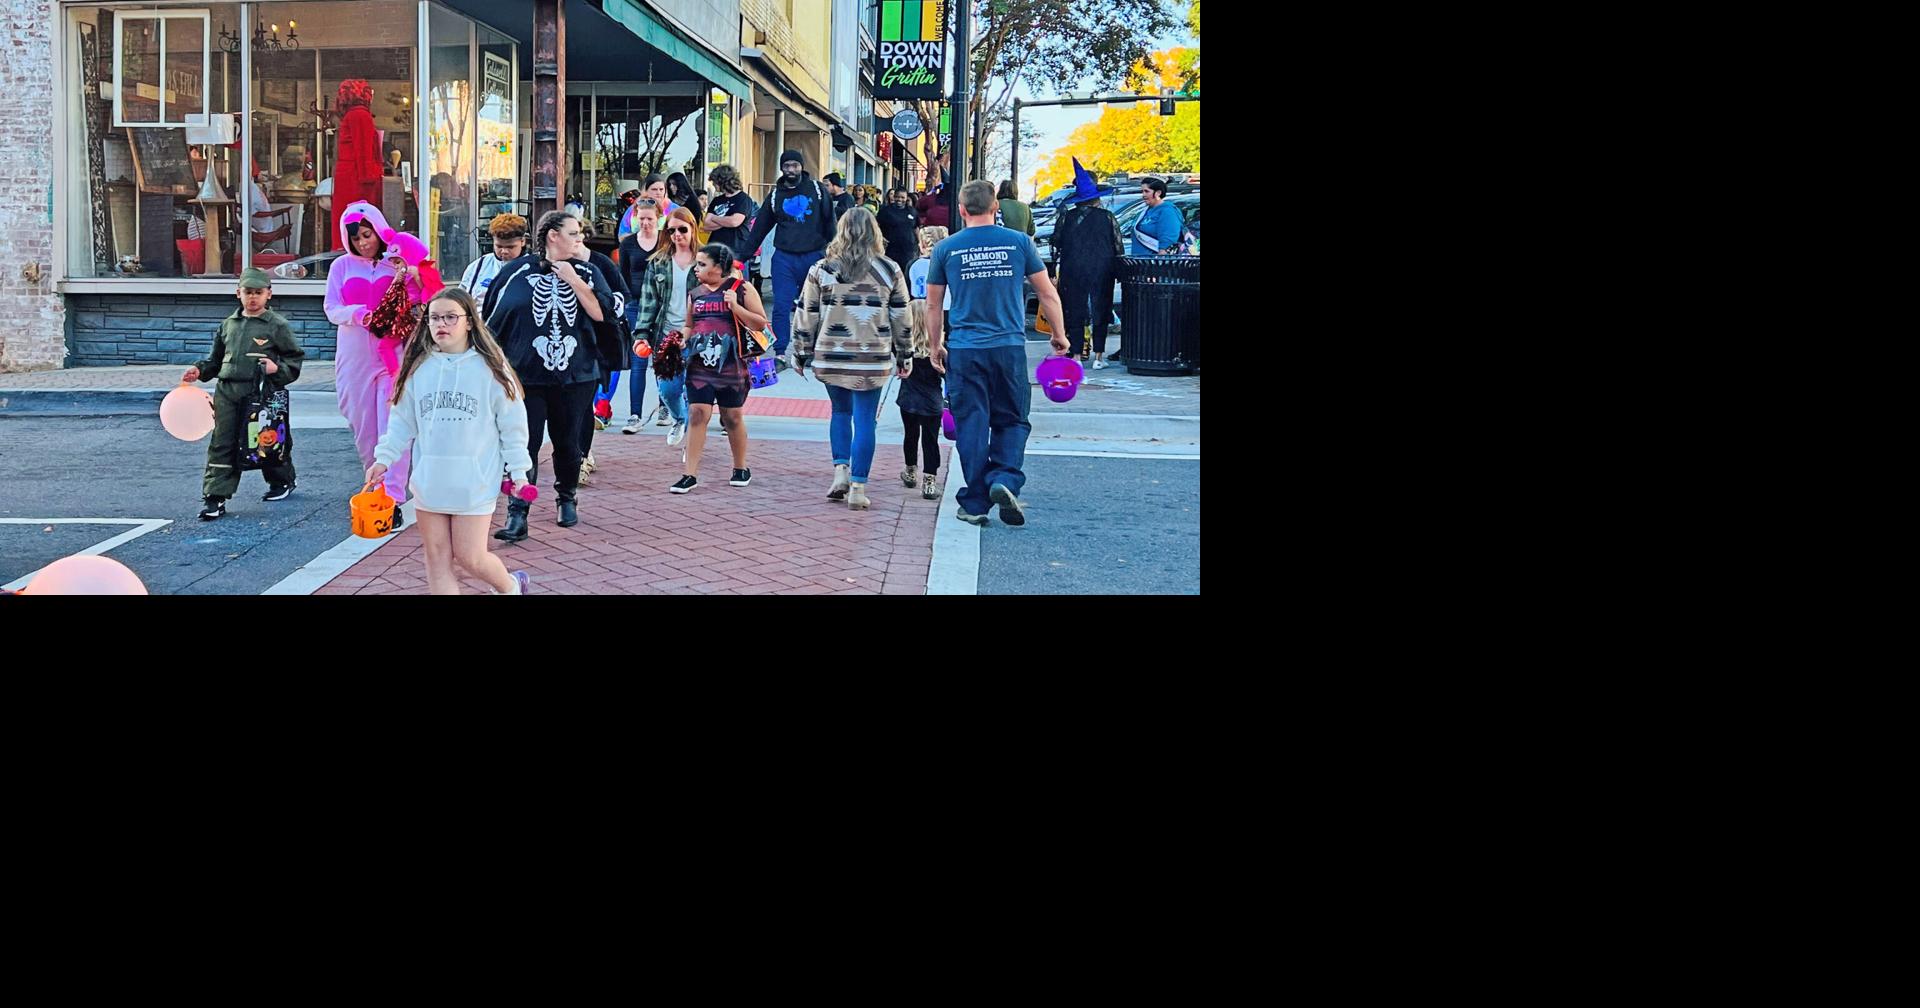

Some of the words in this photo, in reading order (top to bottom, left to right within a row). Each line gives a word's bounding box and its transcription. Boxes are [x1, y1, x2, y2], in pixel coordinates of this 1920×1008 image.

[935, 1, 944, 40] WELCOME
[880, 42, 943, 55] DOWN
[880, 55, 942, 69] TOWN
[881, 64, 937, 89] Griffin
[961, 251, 1008, 264] HAMMOND
[961, 270, 1012, 280] 770-227-5325
[434, 391, 478, 417] ANGELES
